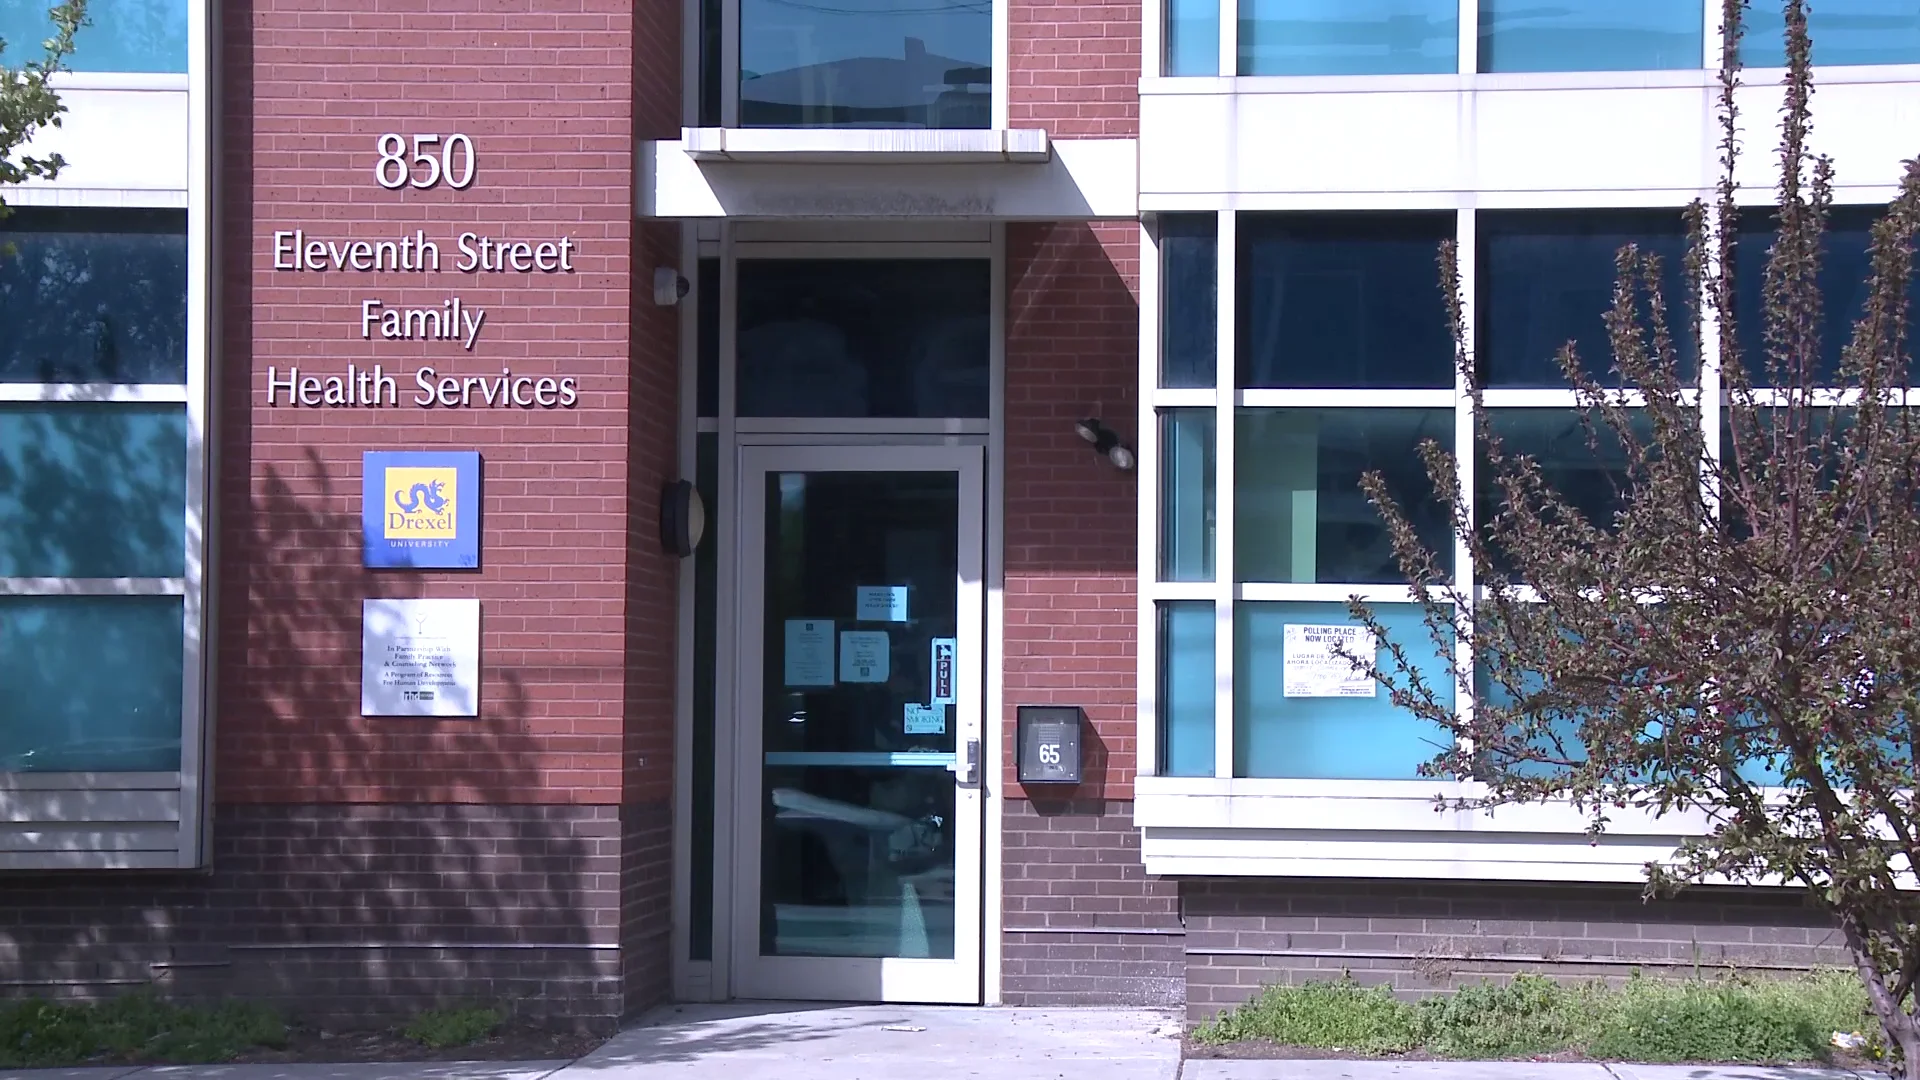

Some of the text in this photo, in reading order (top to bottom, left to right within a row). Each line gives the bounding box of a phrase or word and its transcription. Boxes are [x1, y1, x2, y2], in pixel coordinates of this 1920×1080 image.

[375, 133, 476, 189] 850
[273, 229, 574, 271] Eleventh Street
[362, 297, 485, 349] Family
[267, 364, 577, 407] Health Services
[388, 512, 452, 530] Drexel
[390, 540, 450, 548] UNIVERSITY
[1303, 626, 1332, 635] POLLING
[1334, 627, 1356, 636] PLACE
[1323, 635, 1354, 643] LOCATED
[394, 653, 415, 661] Family
[396, 645, 433, 653] Partnership
[939, 661, 948, 697] PULL
[906, 716, 944, 724] SMOKING
[1039, 743, 1060, 764] 65
